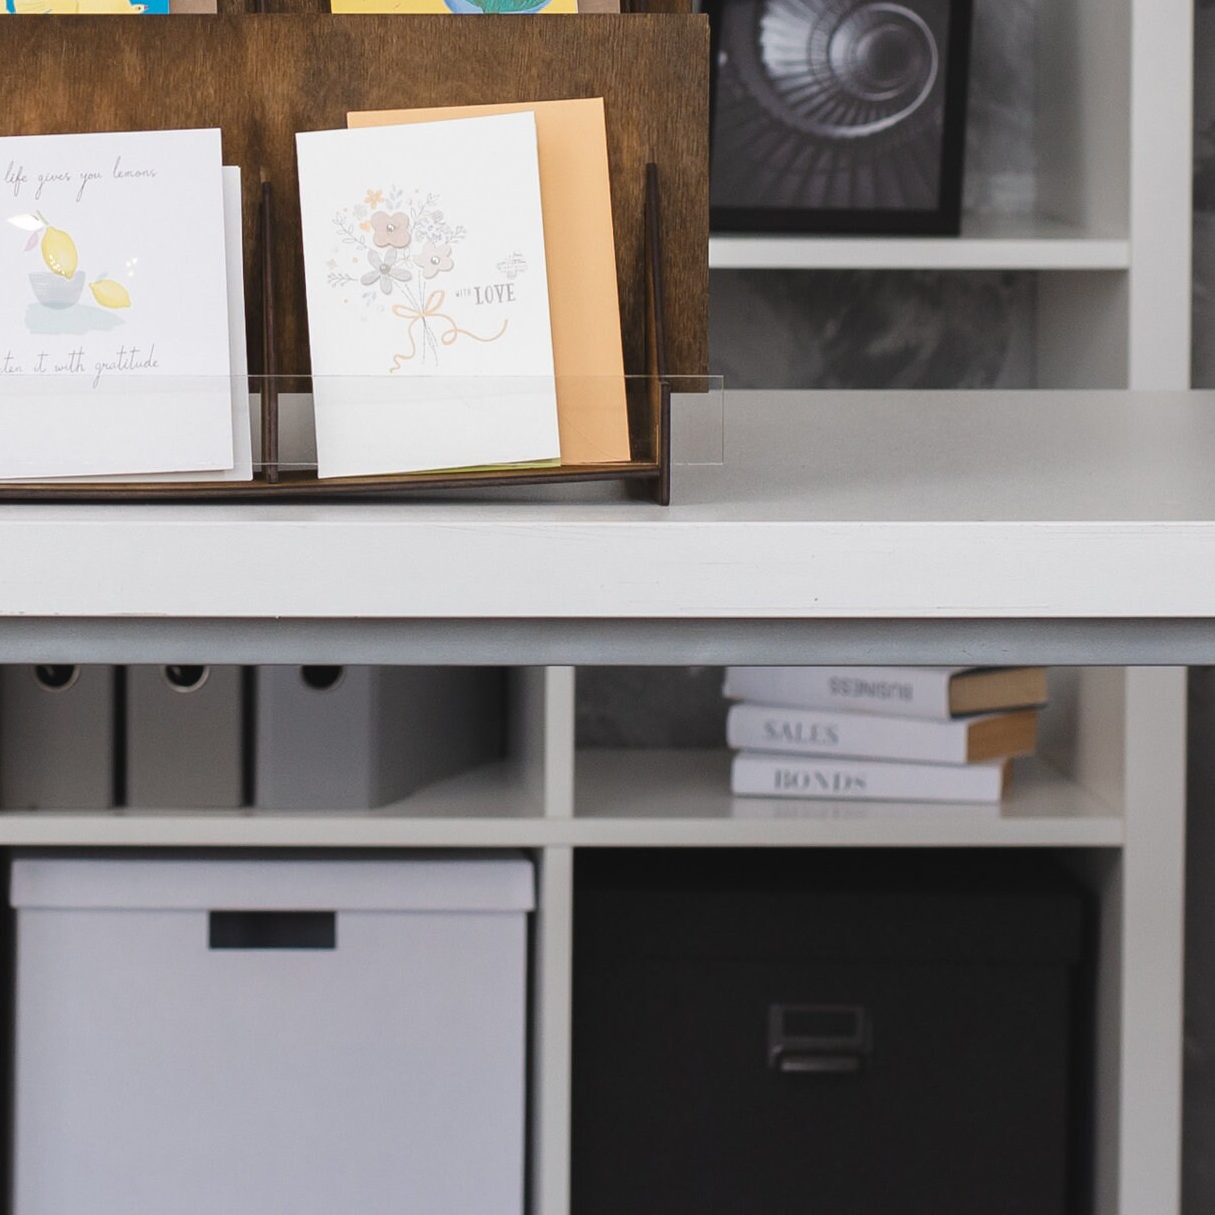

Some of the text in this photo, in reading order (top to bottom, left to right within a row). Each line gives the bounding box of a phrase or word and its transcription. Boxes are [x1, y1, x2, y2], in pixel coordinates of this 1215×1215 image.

[3, 160, 28, 197] life
[35, 171, 71, 201] gives
[75, 171, 103, 203] you
[113, 155, 158, 179] lemons
[474, 283, 517, 306] LOVE
[33, 350, 49, 373] it
[54, 346, 86, 373] with
[92, 343, 160, 389] gratitude
[763, 719, 839, 746] SALES
[774, 768, 867, 792] BONDS
